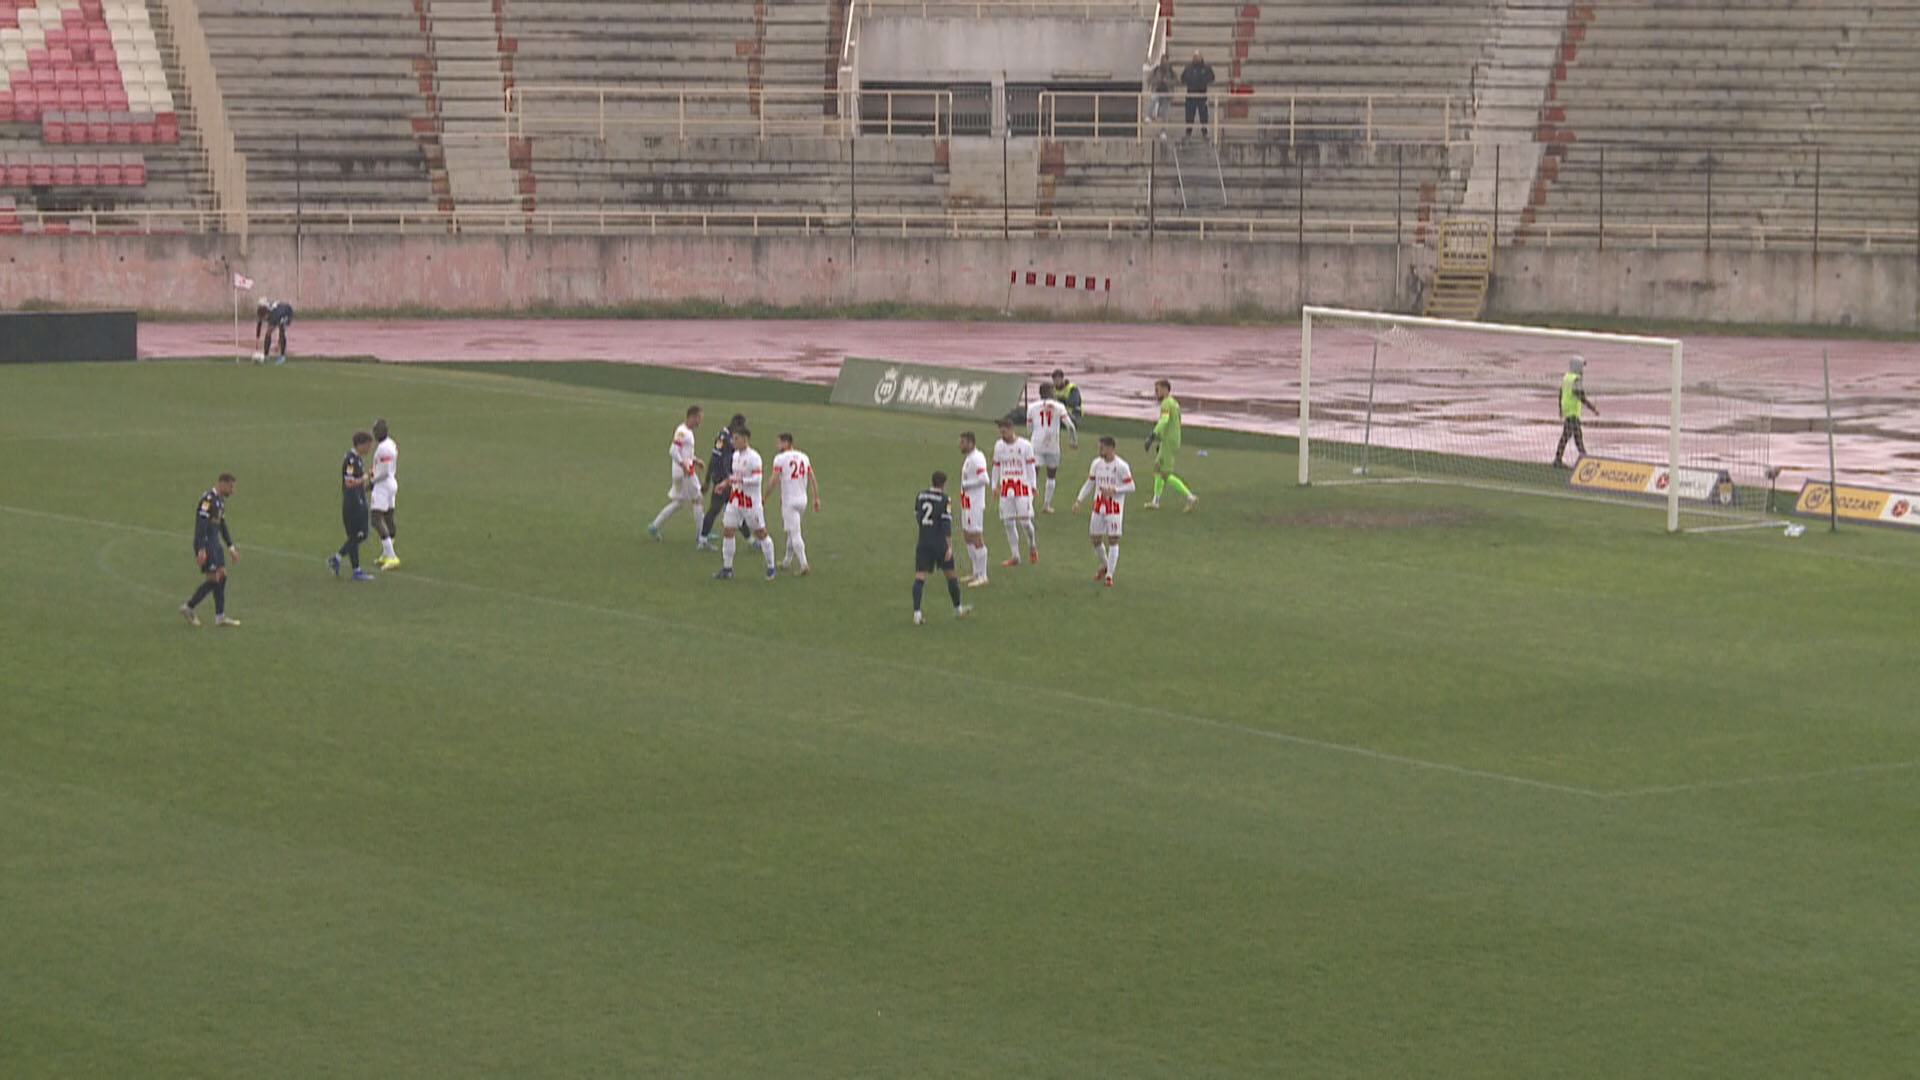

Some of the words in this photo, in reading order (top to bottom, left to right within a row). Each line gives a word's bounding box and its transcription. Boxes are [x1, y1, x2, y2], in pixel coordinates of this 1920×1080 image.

[789, 460, 805, 480] 24
[1599, 469, 1647, 485] MOZZART
[922, 501, 934, 527] 2
